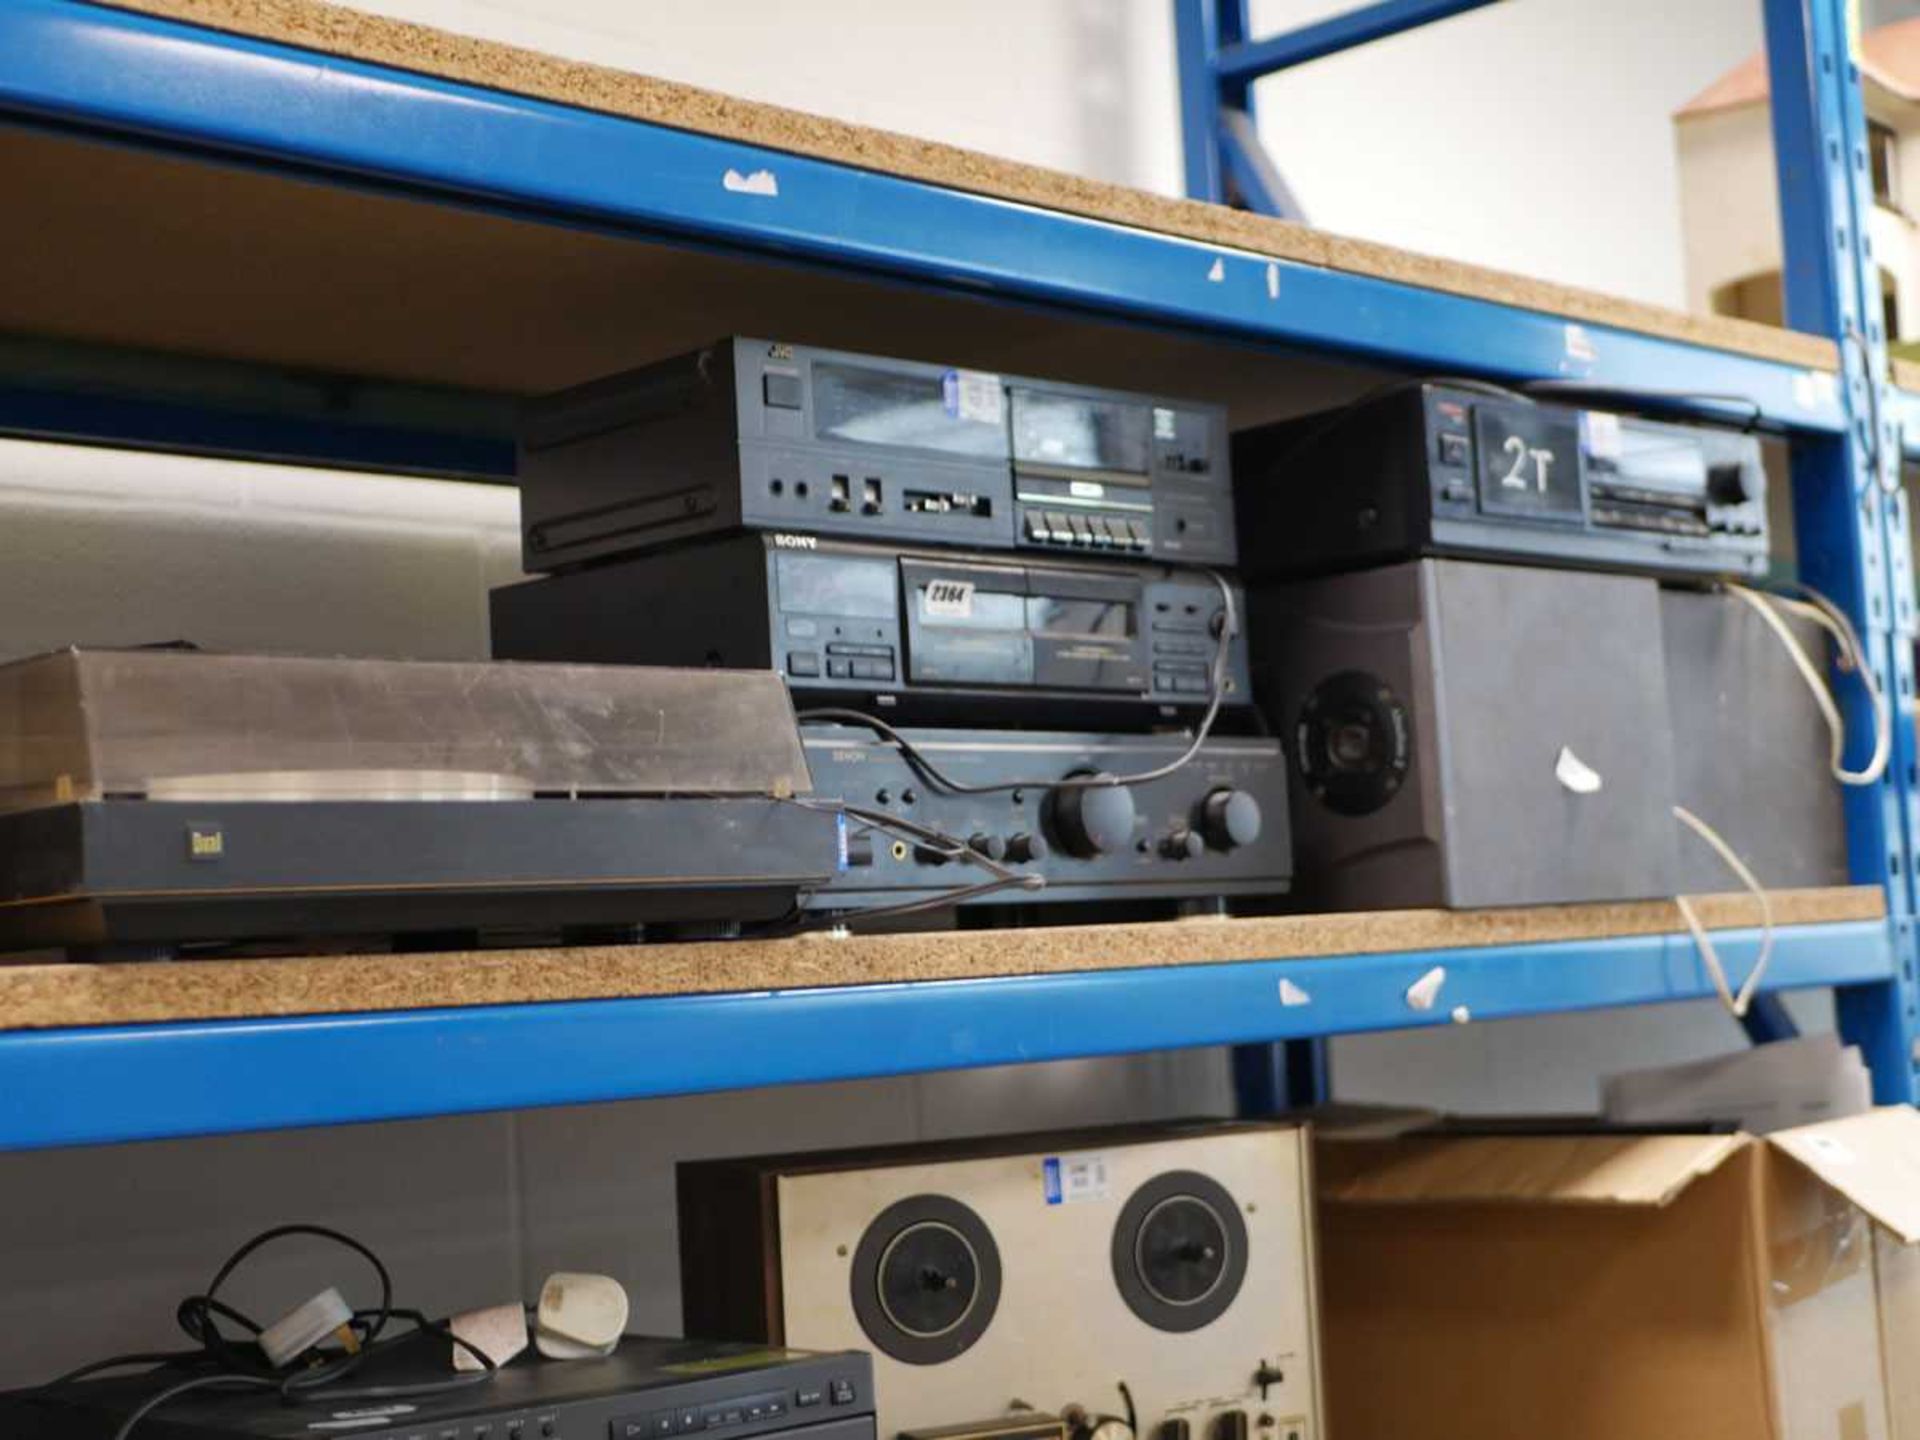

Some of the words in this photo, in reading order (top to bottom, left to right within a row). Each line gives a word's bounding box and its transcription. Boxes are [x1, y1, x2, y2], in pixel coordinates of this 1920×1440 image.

[1501, 434, 1554, 493] 2T
[775, 534, 817, 549] SONY
[191, 831, 223, 855] Dual
